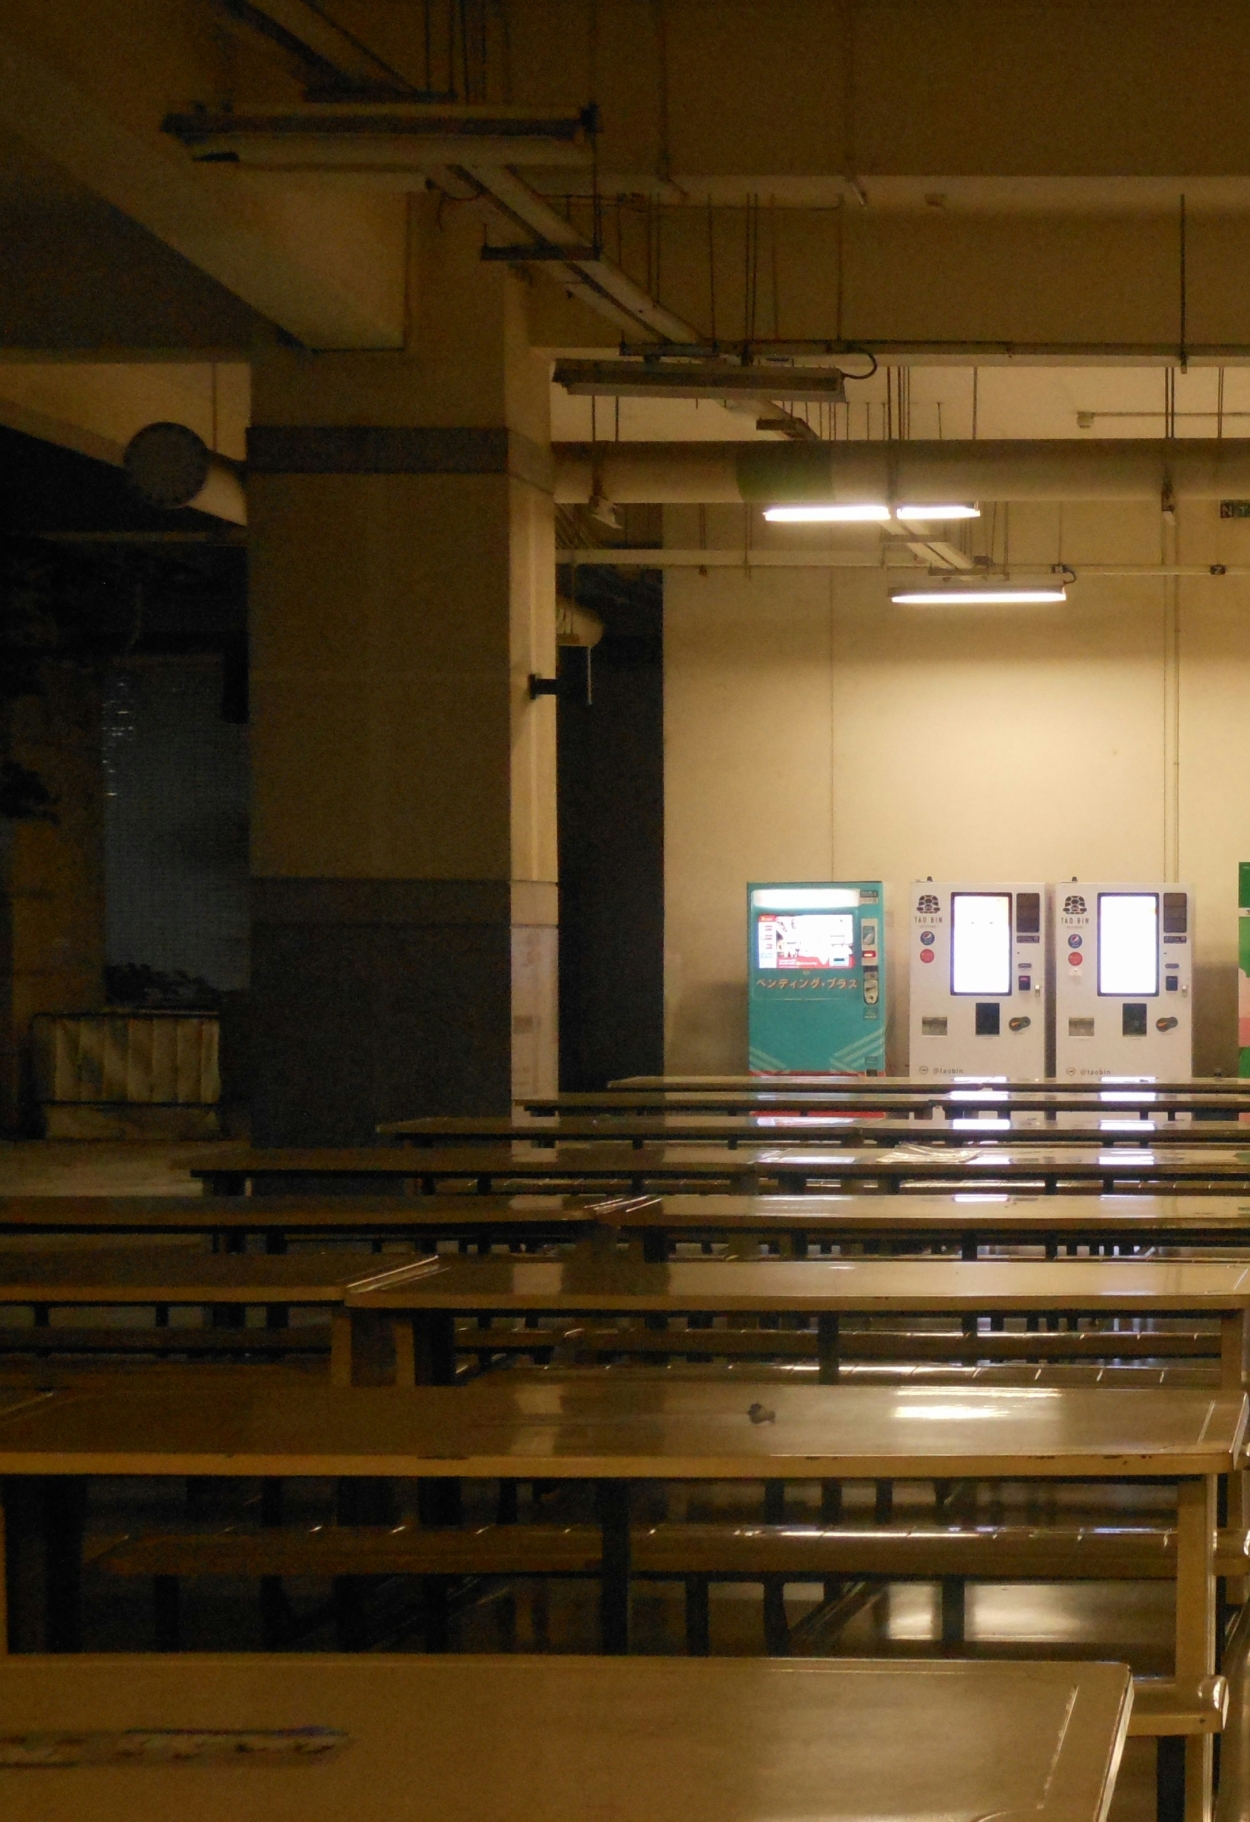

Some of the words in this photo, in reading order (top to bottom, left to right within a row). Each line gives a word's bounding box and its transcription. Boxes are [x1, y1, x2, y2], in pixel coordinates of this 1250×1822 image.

[914, 916, 927, 924] TAO
[930, 916, 943, 924] BIN
[1060, 917, 1074, 925] TAO
[1076, 917, 1090, 925] BIN
[932, 1067, 964, 1075] @taobin
[1080, 1068, 1111, 1076] @taobin
